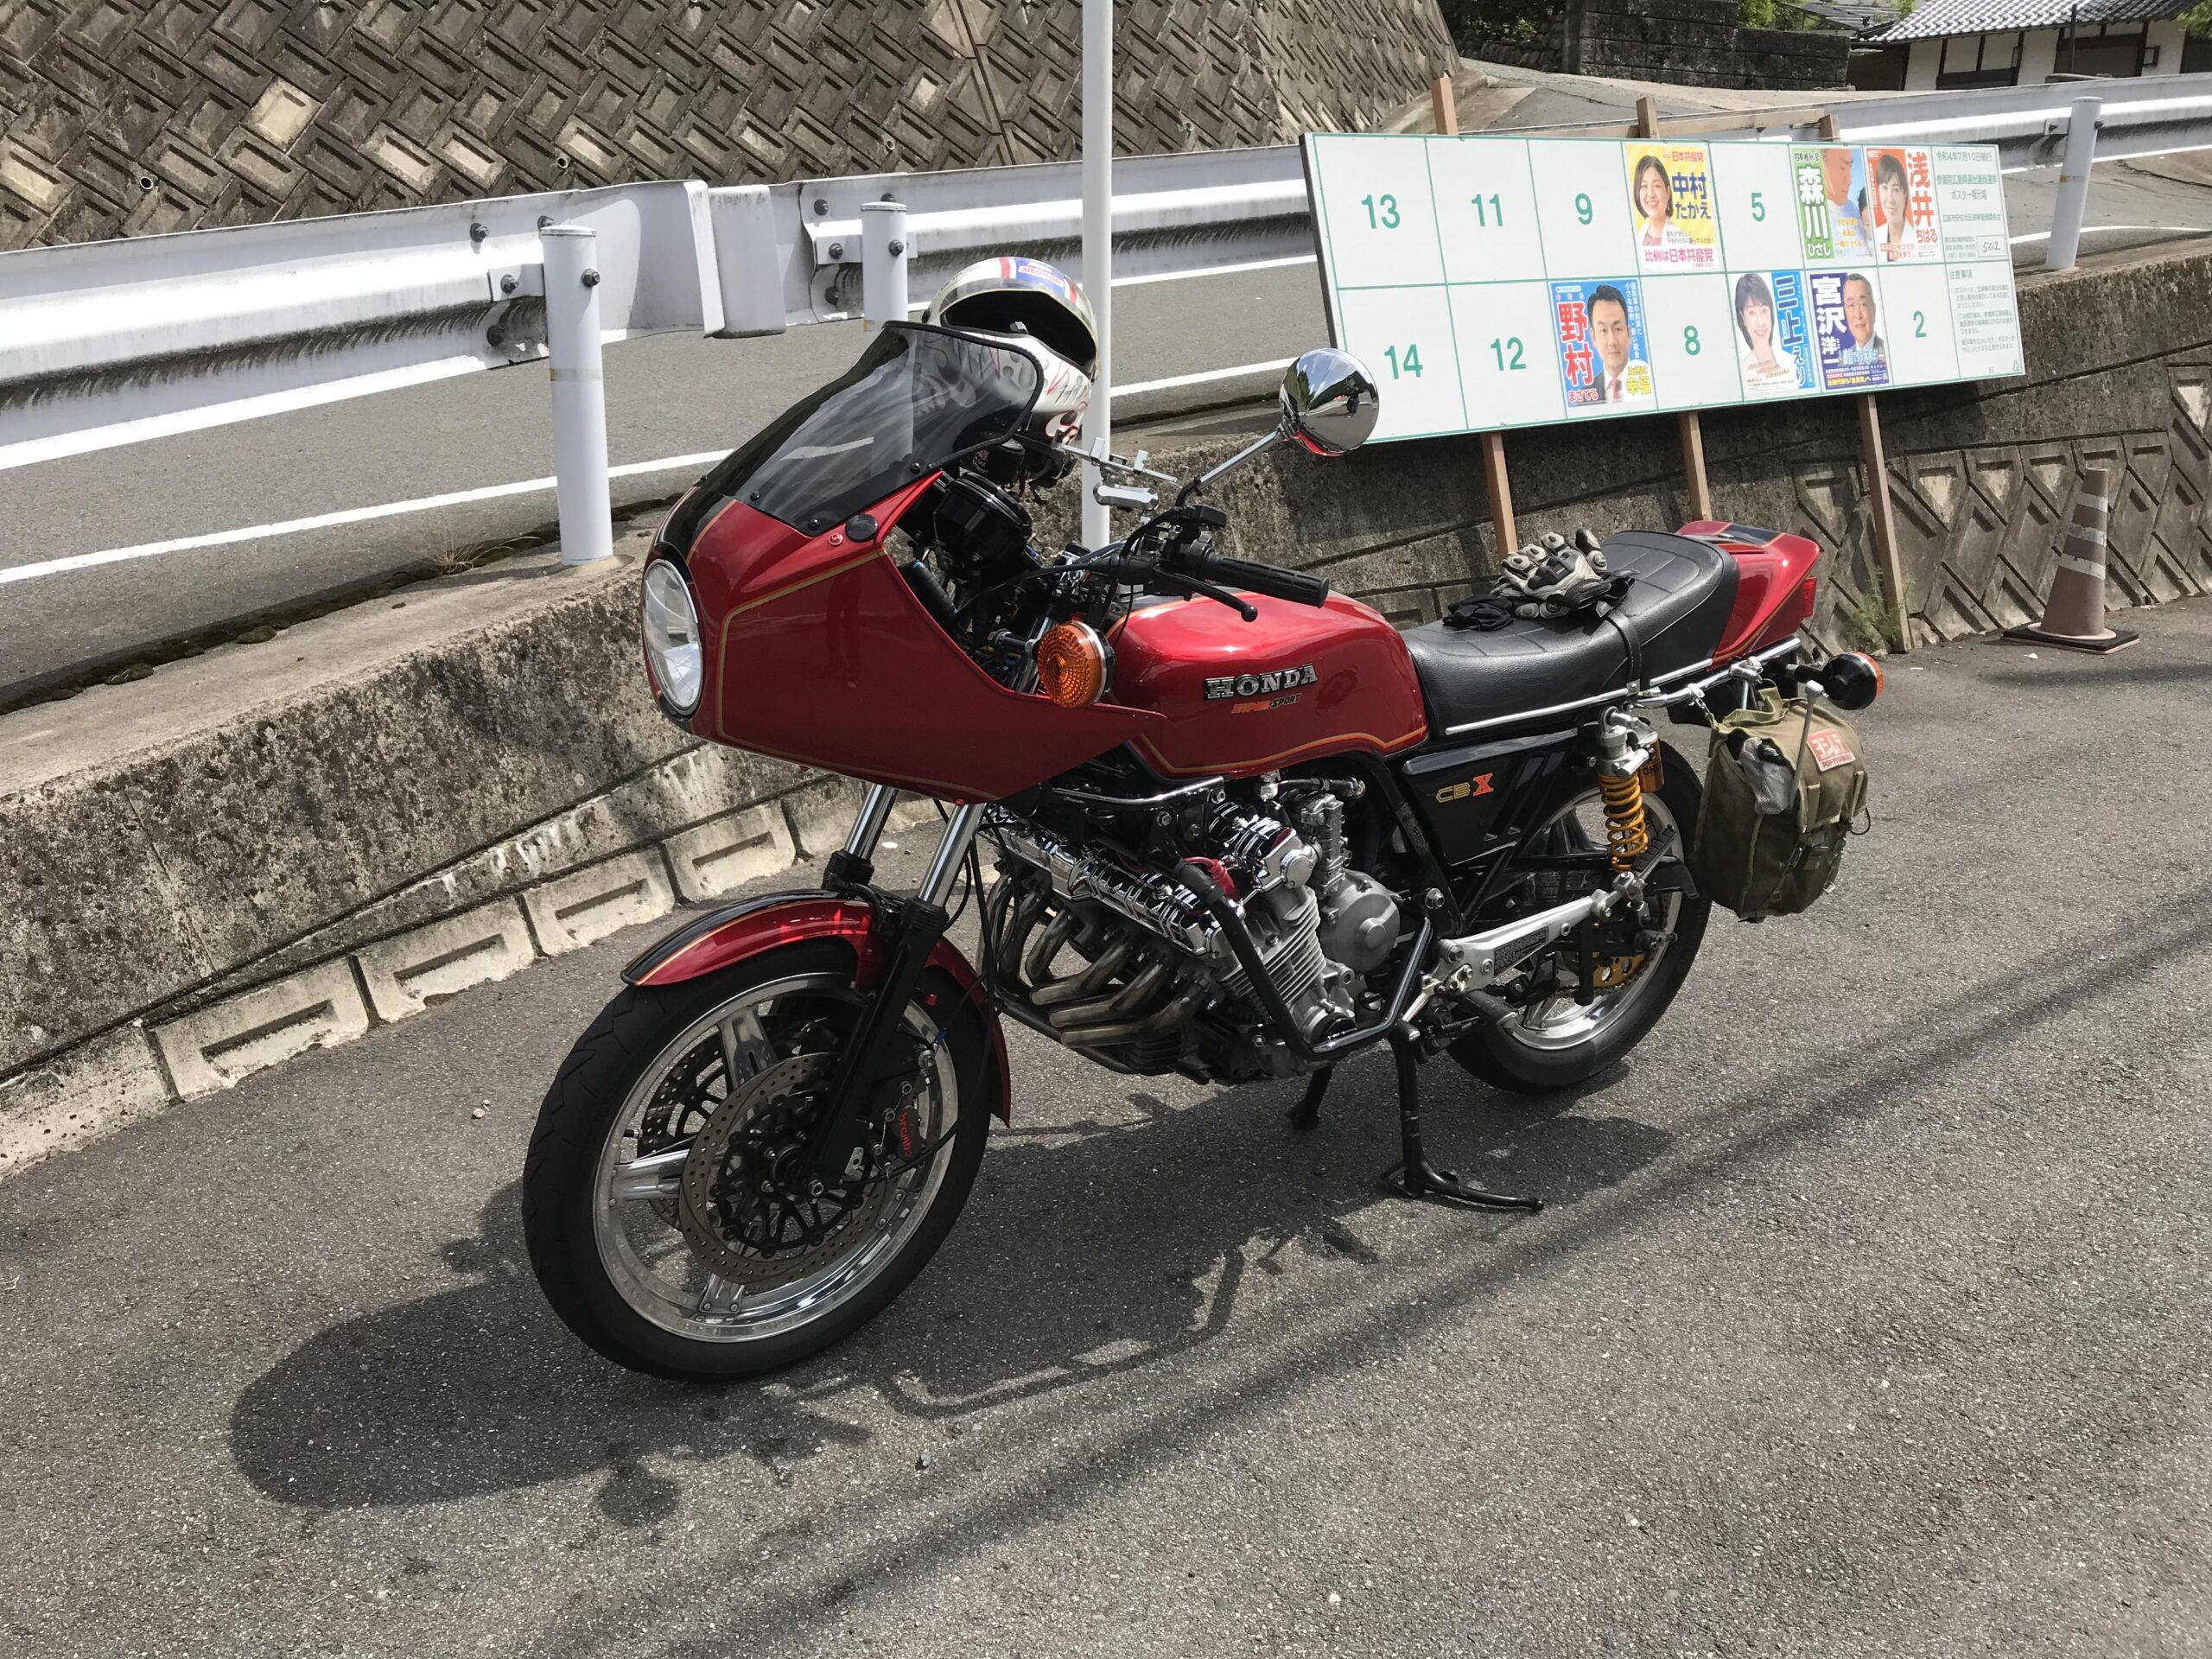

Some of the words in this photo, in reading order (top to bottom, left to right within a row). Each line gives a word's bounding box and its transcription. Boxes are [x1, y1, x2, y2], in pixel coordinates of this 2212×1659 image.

[1671, 172, 1707, 200] 中村
[1907, 151, 1935, 227] 浅井
[1361, 194, 1401, 229] 13
[1471, 194, 1503, 227] 11
[1574, 193, 1593, 226] 9
[1675, 201, 1712, 220] たかえ
[1751, 192, 1766, 222] 5
[1796, 165, 1830, 240] 森川
[1807, 242, 1832, 257] ひさし
[1916, 228, 1939, 244] ちはる
[1982, 241, 2001, 252] 502
[1683, 325, 1700, 355] 8
[1912, 310, 1927, 338] 2
[1490, 336, 1527, 371] 12
[1557, 301, 1595, 387] 野村
[1384, 344, 1424, 379] 14
[1204, 663, 1319, 701] HONDA
[1269, 693, 1302, 709] SPORT
[1435, 772, 1494, 804] CBX
[899, 1111, 912, 1157] brembo
